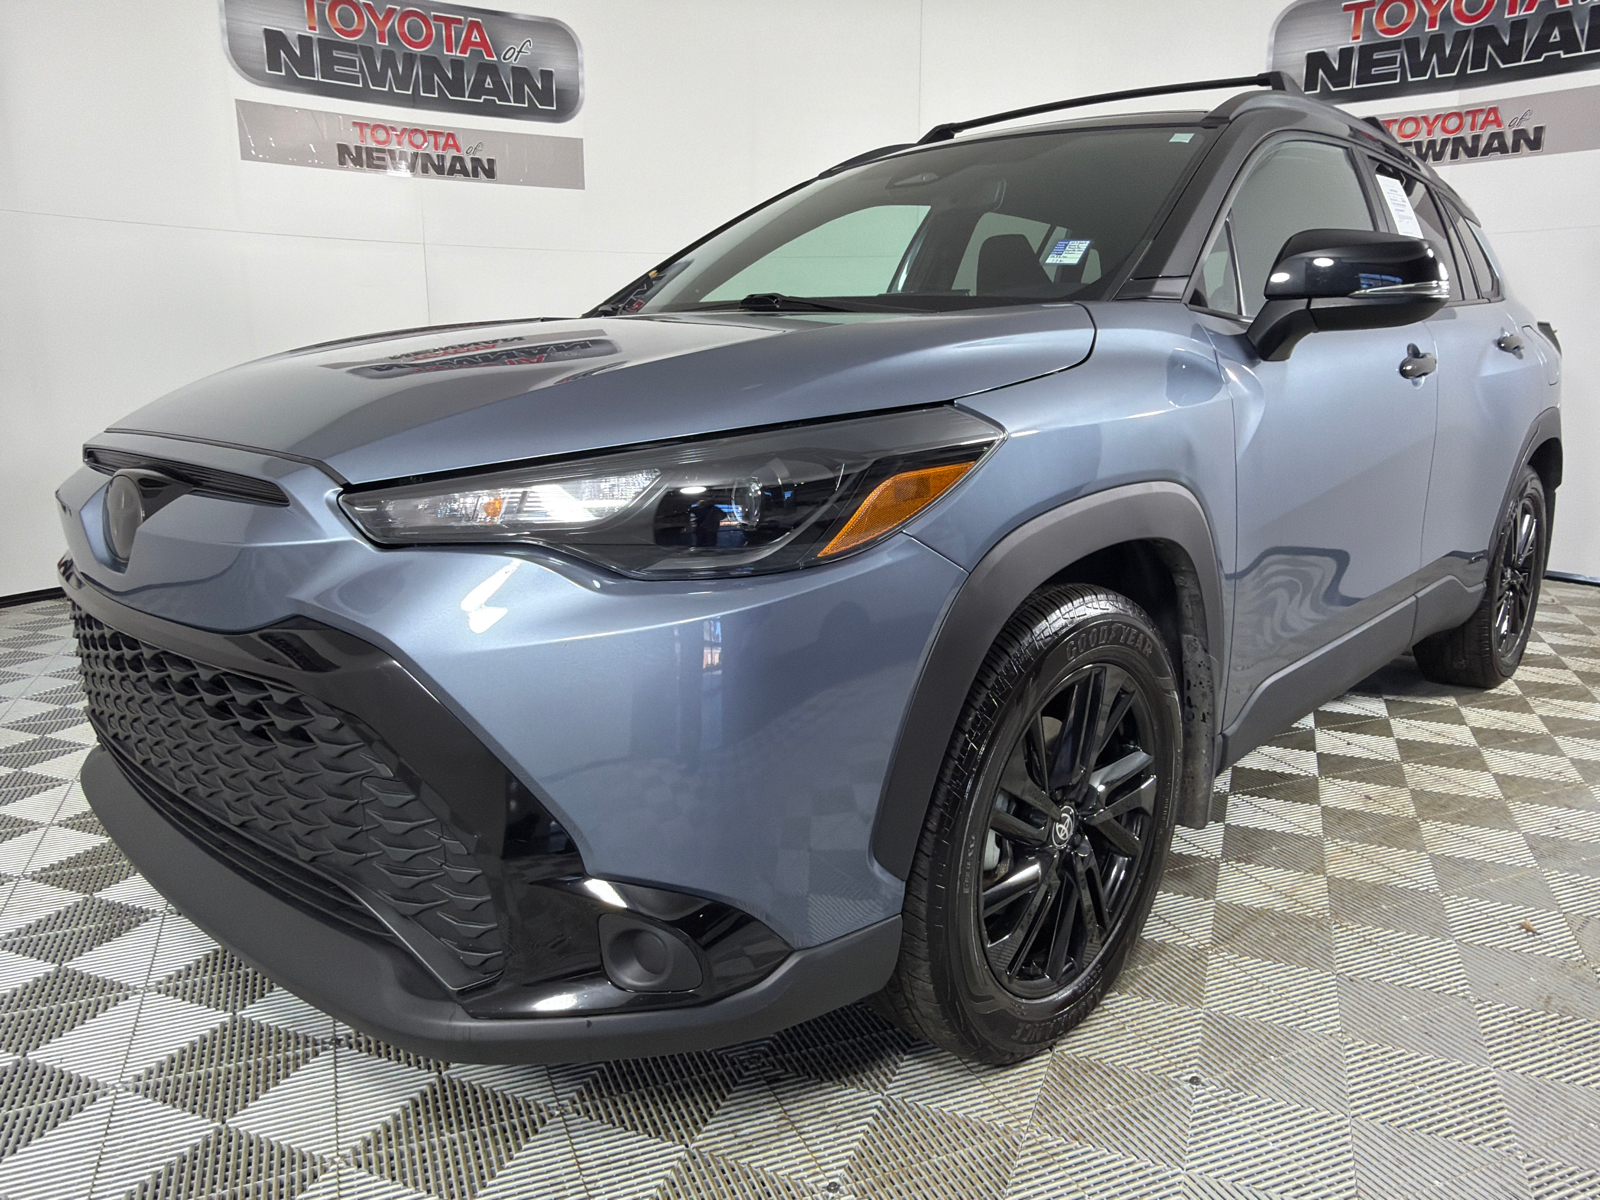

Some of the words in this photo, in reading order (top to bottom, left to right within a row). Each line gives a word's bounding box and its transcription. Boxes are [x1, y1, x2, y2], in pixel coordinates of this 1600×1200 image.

[304, 0, 497, 60] TOYOTA
[501, 39, 532, 63] of
[1303, 2, 1600, 94] NEWNA
[262, 27, 557, 110] NEWNAN
[1508, 108, 1532, 129] of
[352, 121, 462, 154] TOYOTA
[465, 141, 483, 156] of
[336, 143, 497, 181] NEWNAN
[1065, 623, 1154, 662] GOODYEAR
